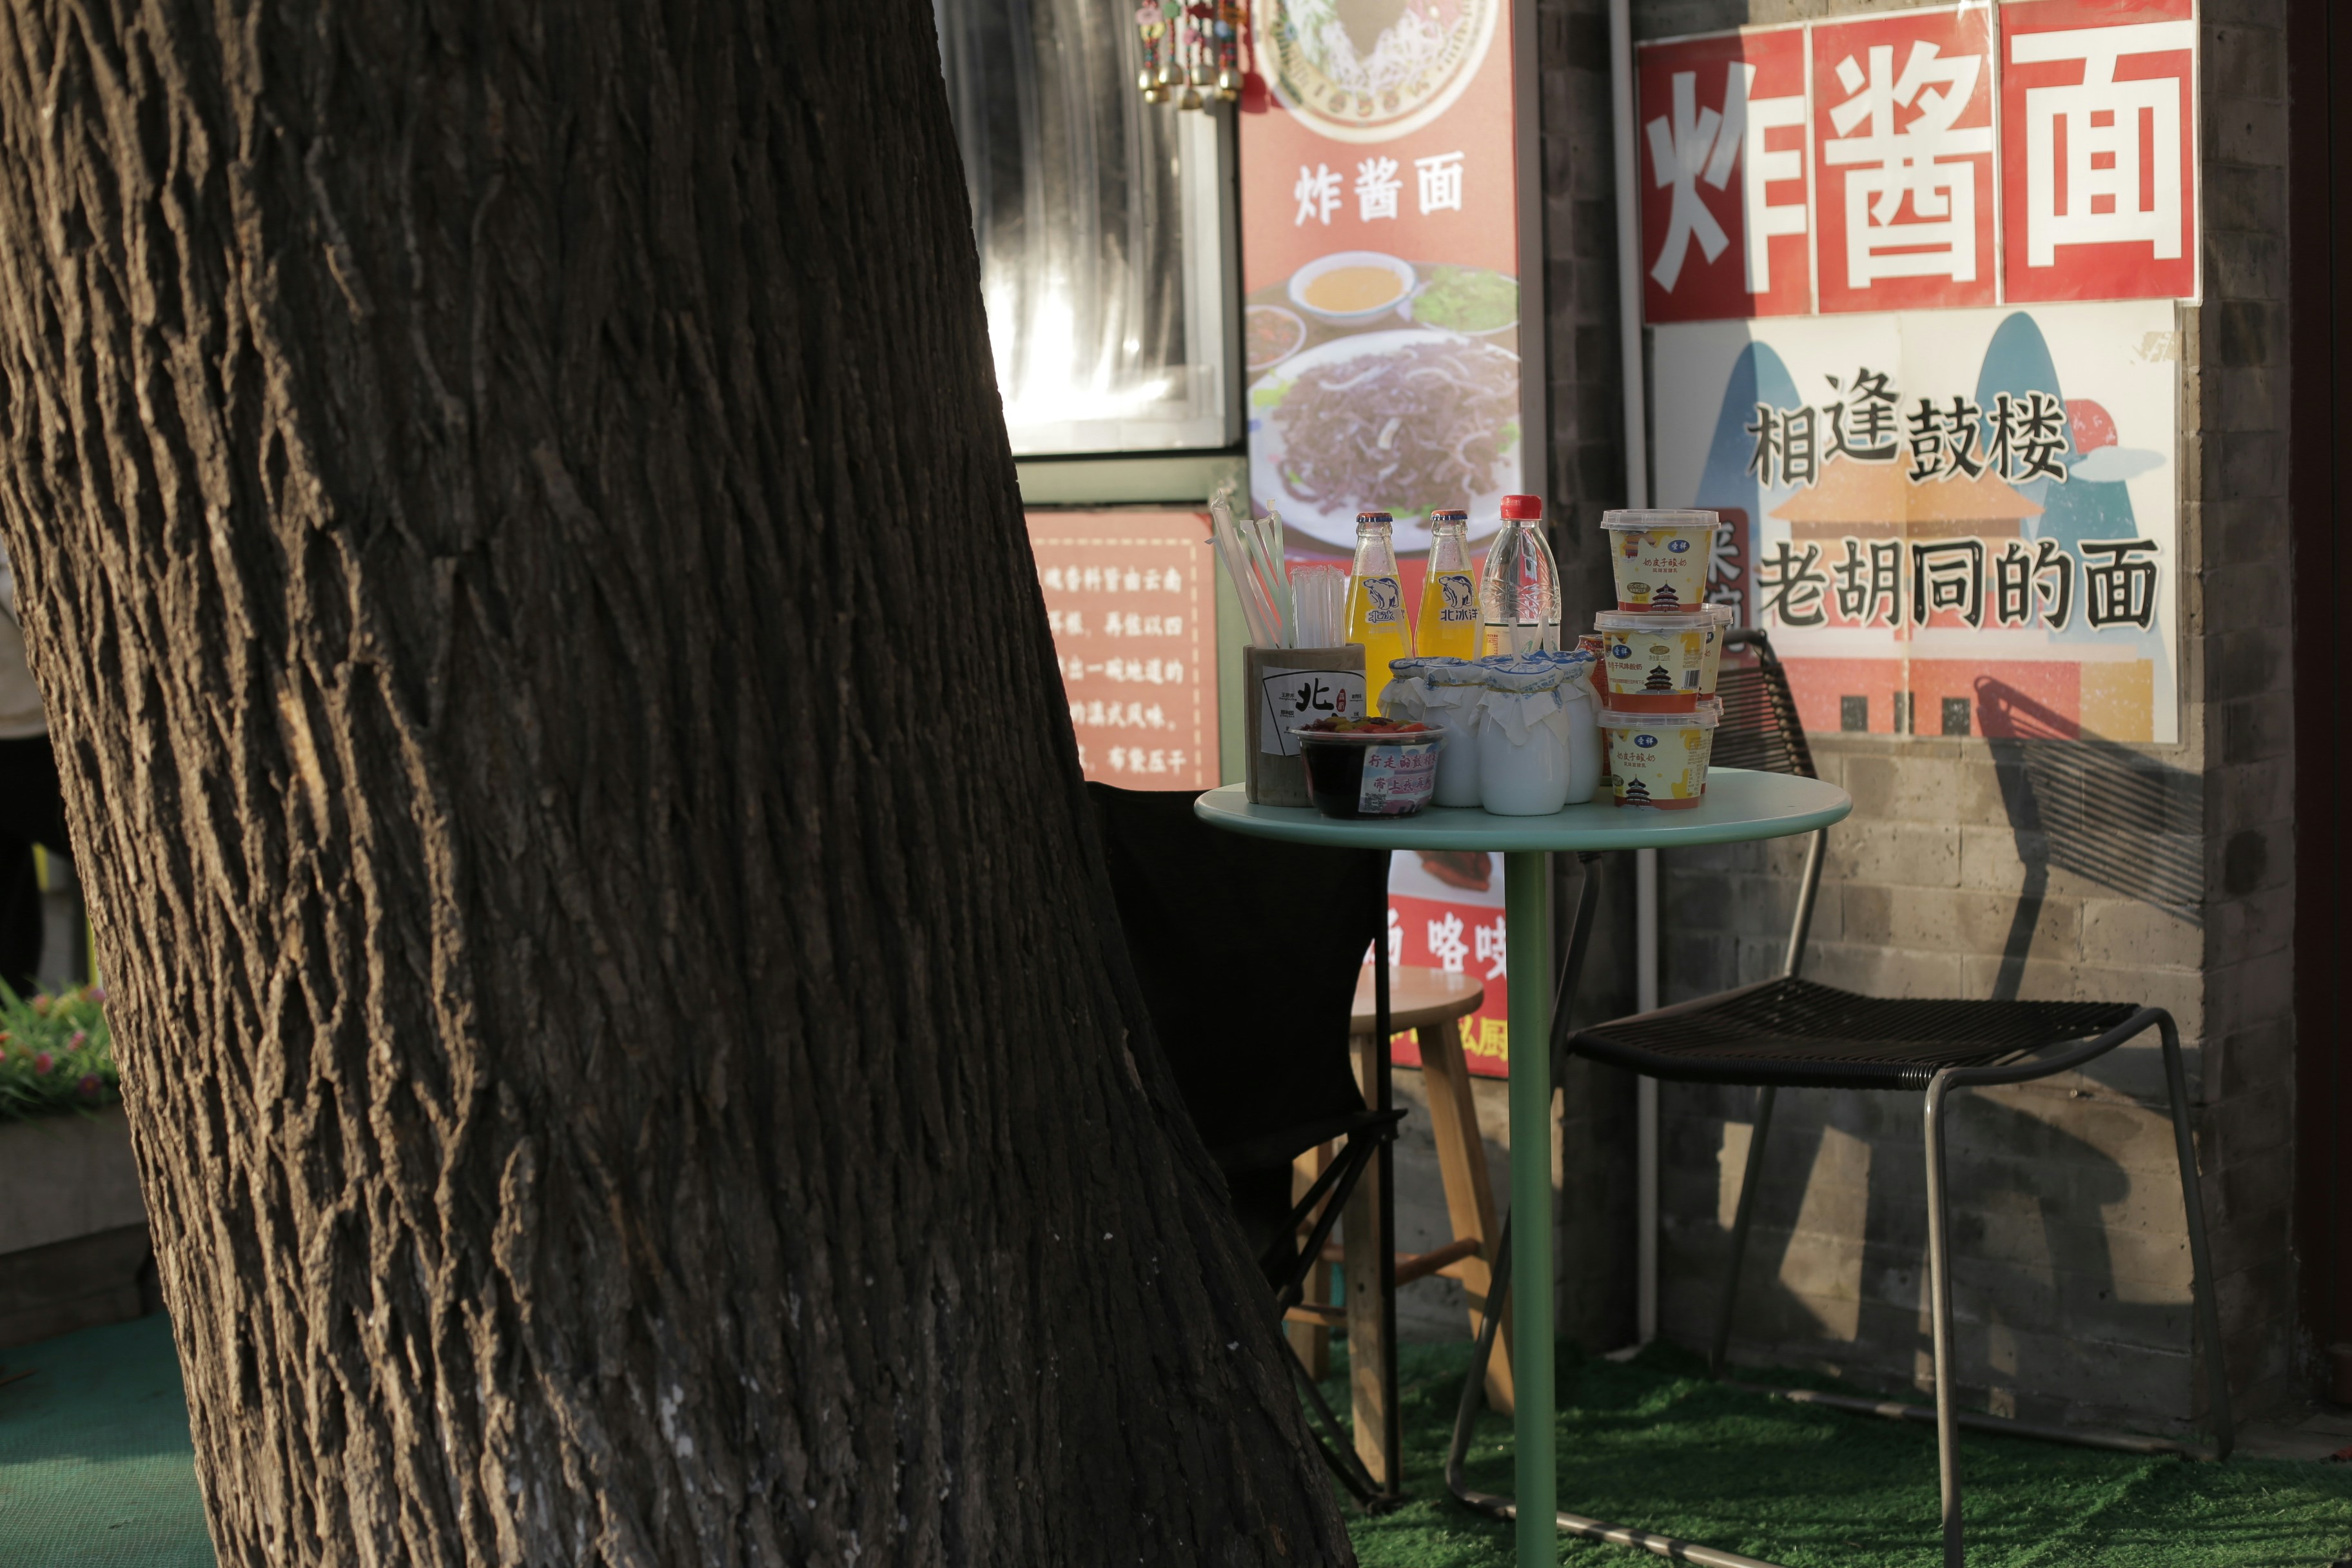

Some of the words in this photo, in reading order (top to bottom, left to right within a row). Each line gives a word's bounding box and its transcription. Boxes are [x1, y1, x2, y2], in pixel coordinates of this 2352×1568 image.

[1645, 19, 2193, 294] 炸酱面
[1294, 151, 1465, 226] 炸酱面
[1747, 367, 2067, 484] 相逢鼓楼
[1643, 558, 1687, 567] 奶皮子酸奶
[1758, 538, 2160, 629] 老胡同的面
[1368, 610, 1405, 623] 北冰
[1440, 609, 1478, 622] 北冰洋
[1616, 751, 1656, 762] 奶皮子酸奶
